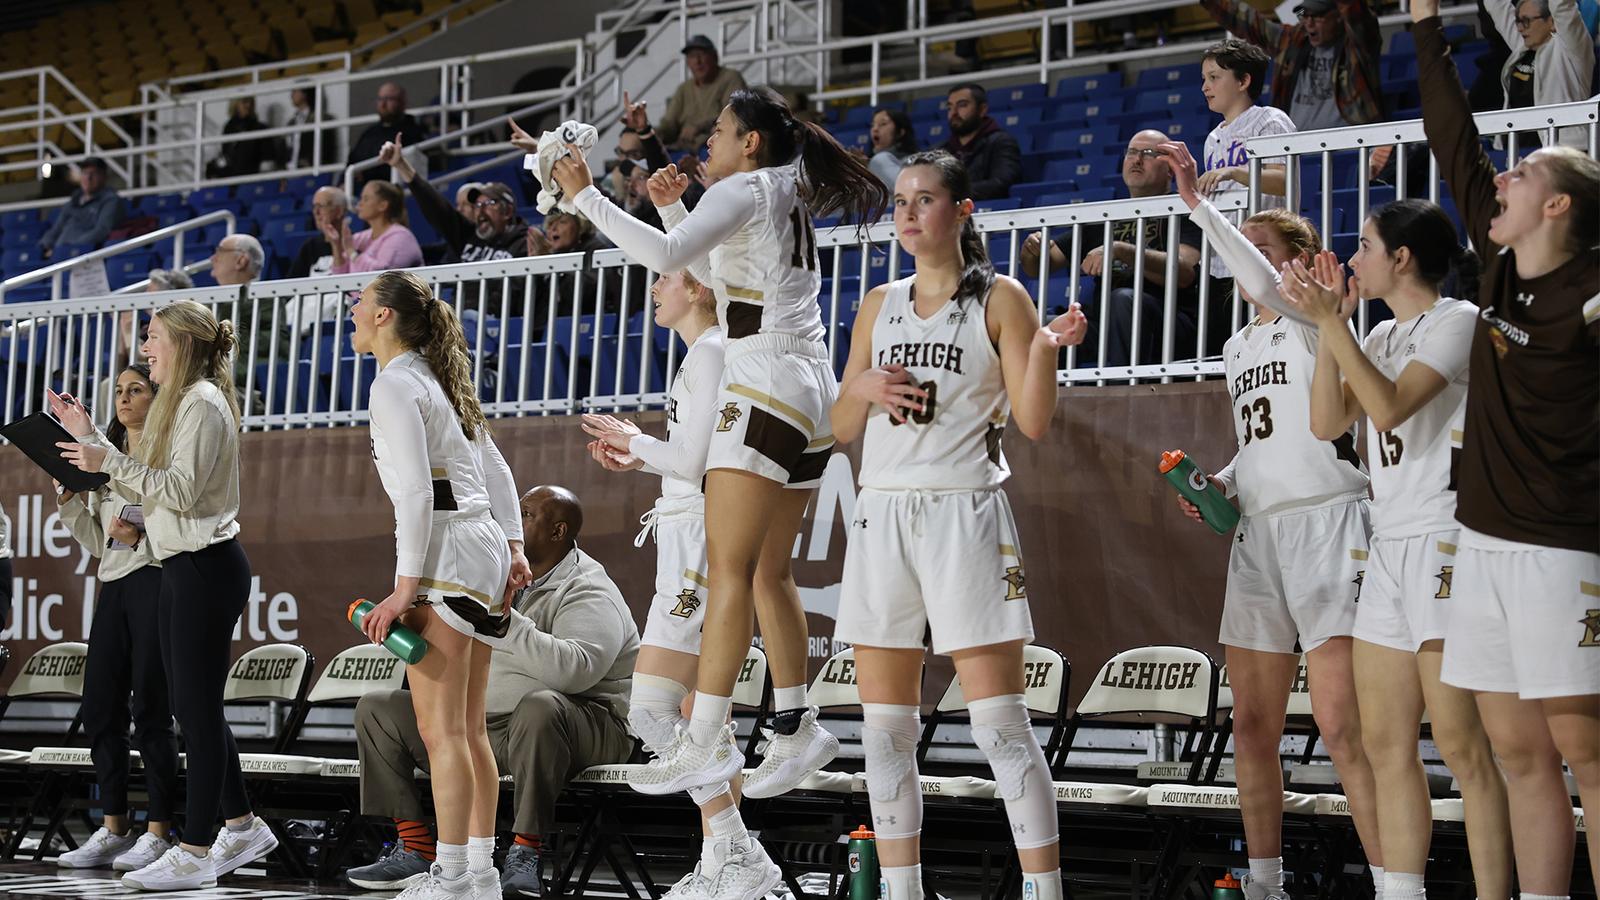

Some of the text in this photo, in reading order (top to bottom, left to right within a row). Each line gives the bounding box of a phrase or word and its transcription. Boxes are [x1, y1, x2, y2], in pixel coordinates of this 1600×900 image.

[878, 342, 965, 375] LEHIGH
[1241, 396, 1274, 446] 33
[1377, 430, 1404, 467] 15
[23, 656, 86, 677] LEHIGH
[231, 658, 300, 681] LEHIGH
[327, 657, 400, 681] LEHIGH
[1101, 661, 1202, 690] LEHIGH
[239, 760, 288, 771] NTAIN HAWKS
[329, 764, 360, 774] MOUNTAI
[578, 770, 623, 780] MOUNTAIN
[919, 781, 941, 793] WKS
[1057, 787, 1093, 799] HAWKS
[1161, 791, 1241, 806] MOUNTAIN HAW
